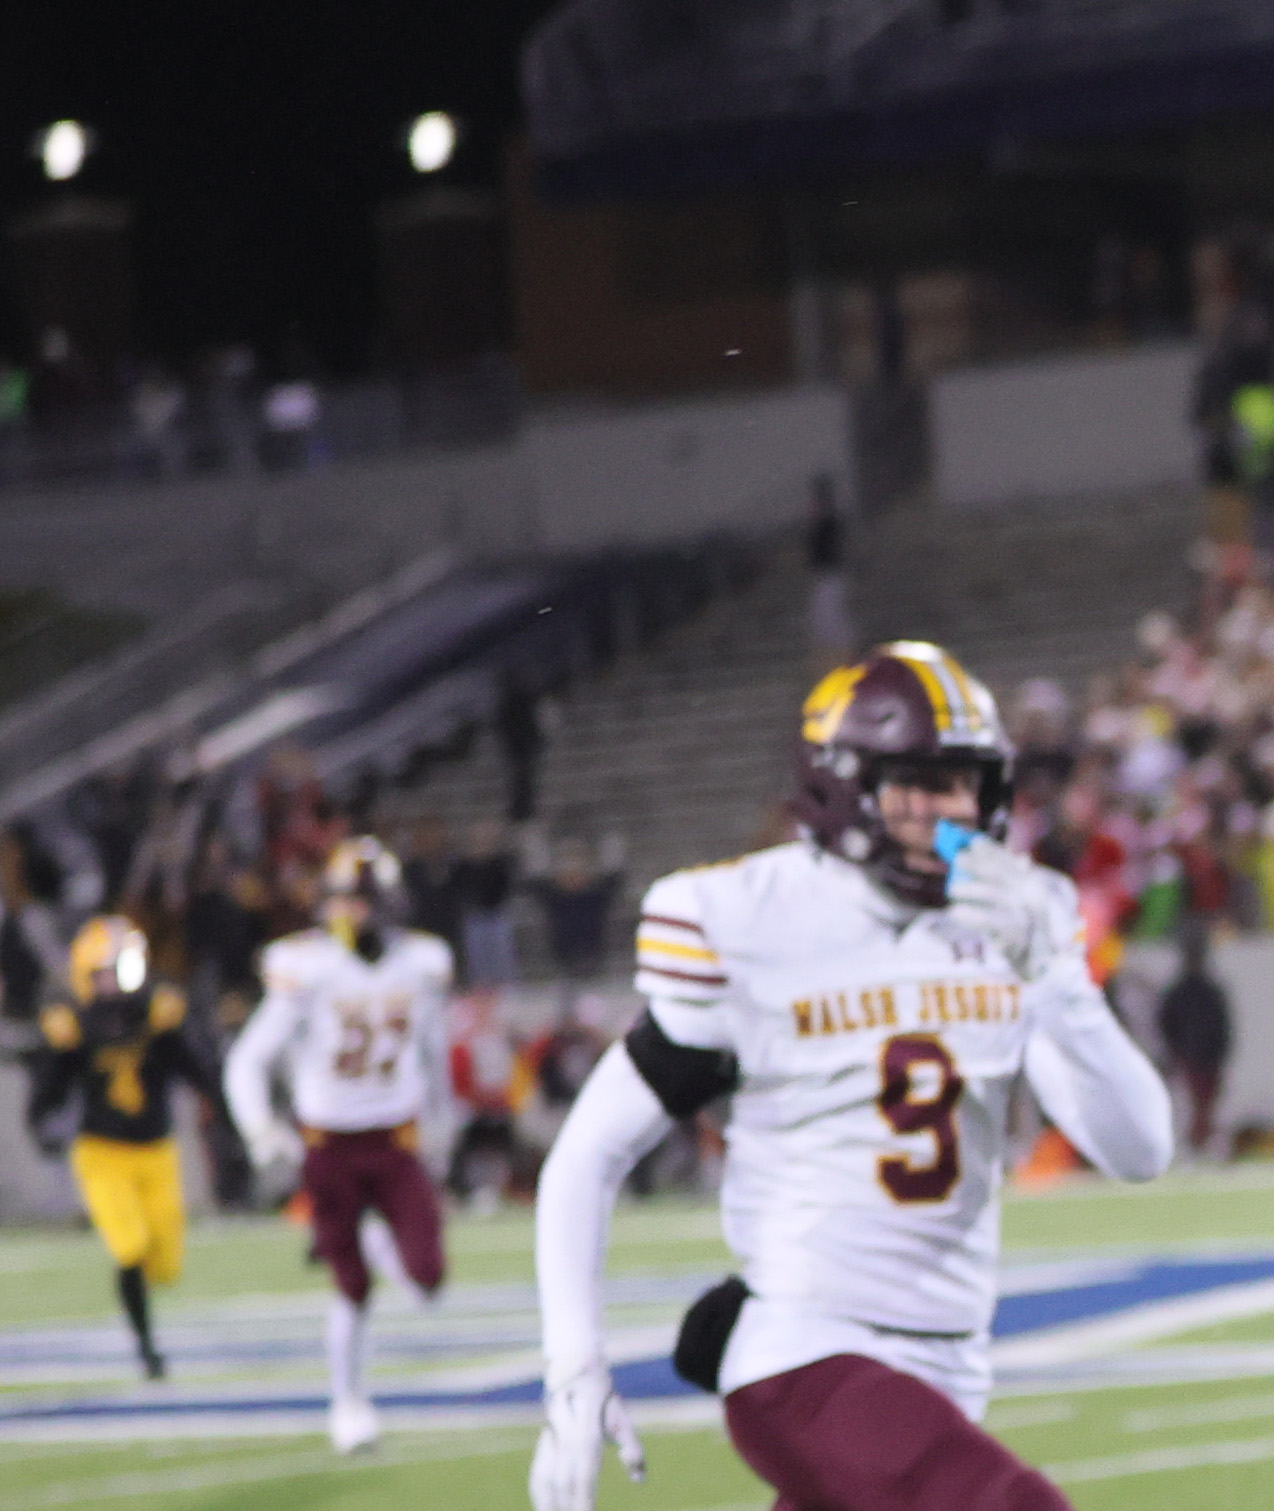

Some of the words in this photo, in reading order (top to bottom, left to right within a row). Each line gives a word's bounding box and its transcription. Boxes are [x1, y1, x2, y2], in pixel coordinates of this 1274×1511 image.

[793, 985, 898, 1039] WALSH
[918, 980, 1021, 1023] JESUIT
[874, 1030, 962, 1207] 9
